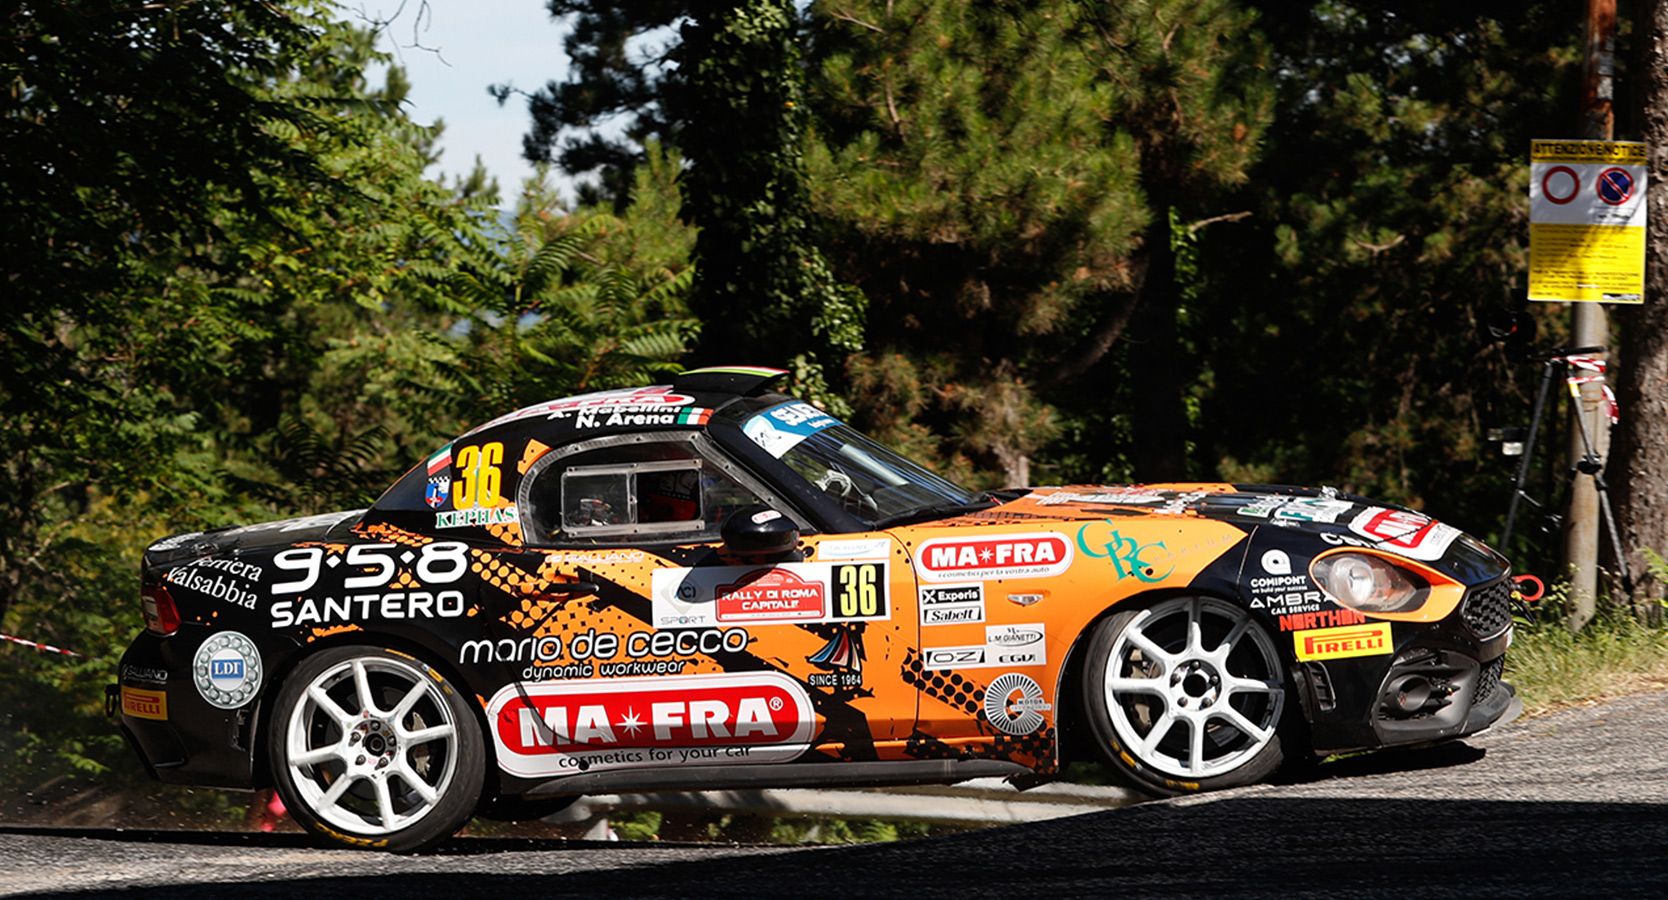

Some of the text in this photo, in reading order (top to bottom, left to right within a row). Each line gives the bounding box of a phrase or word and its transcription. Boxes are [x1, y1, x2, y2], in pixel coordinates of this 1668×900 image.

[575, 412, 674, 429] N. Arena
[452, 441, 504, 511] 36
[437, 510, 515, 528] KEPHAS
[166, 565, 258, 609] Valsabbia
[721, 588, 819, 601] RALLY DI ROMA
[839, 564, 878, 616] 36
[271, 590, 465, 628] SANTERO
[741, 600, 800, 610] CAPITALE
[660, 615, 707, 625] SPORT
[459, 627, 748, 664] mario de cecco
[1304, 630, 1383, 655] PIRELLI
[522, 660, 686, 682] dynamic workwear
[809, 674, 838, 686] SINCE
[649, 747, 673, 761] for
[680, 747, 719, 763] your
[725, 746, 750, 757] car
